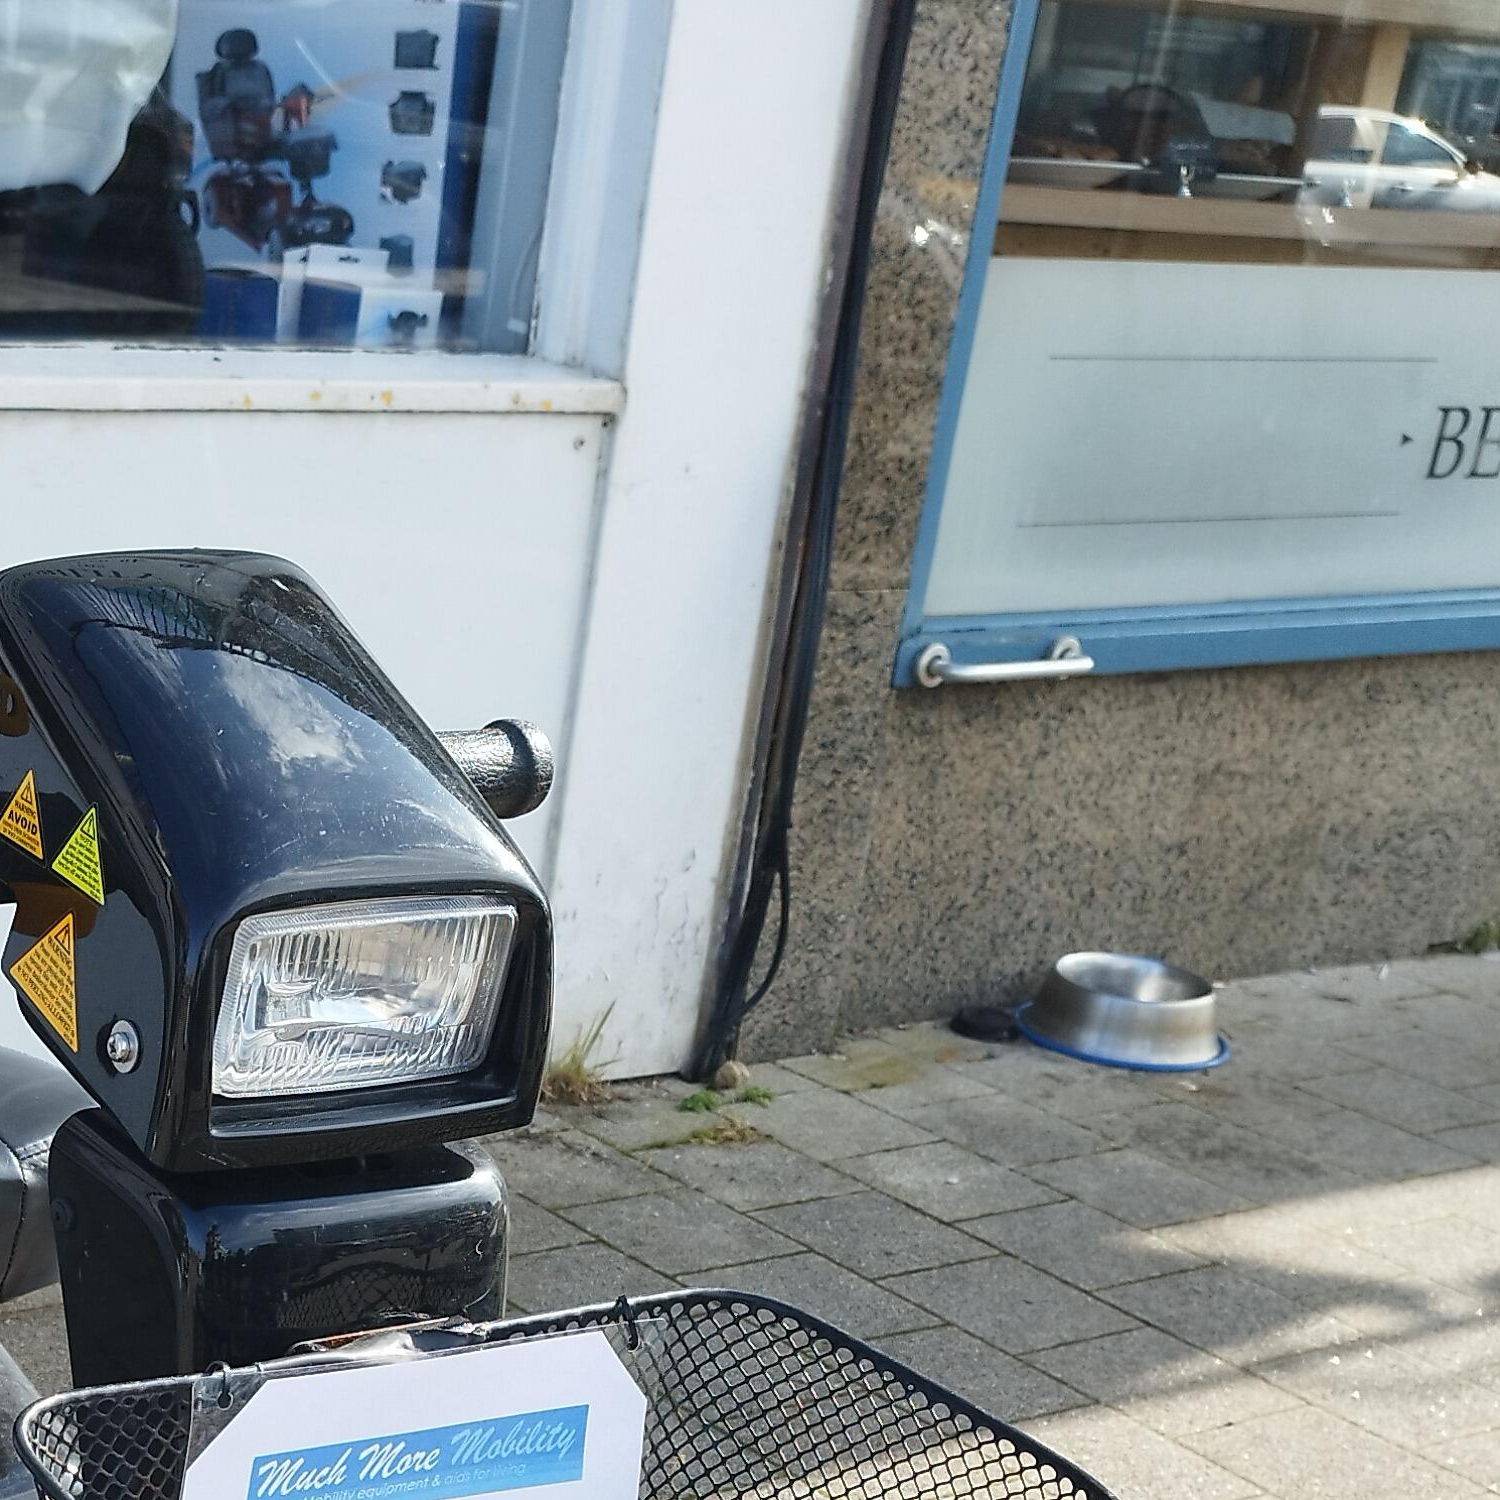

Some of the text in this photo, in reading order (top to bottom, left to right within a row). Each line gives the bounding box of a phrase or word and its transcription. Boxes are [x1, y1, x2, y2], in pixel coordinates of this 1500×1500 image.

[7, 809, 38, 835] AVOID
[257, 1419, 577, 1498] Much More Mobility
[431, 1474, 441, 1487] &
[444, 1469, 471, 1486] aids
[473, 1467, 491, 1482] for
